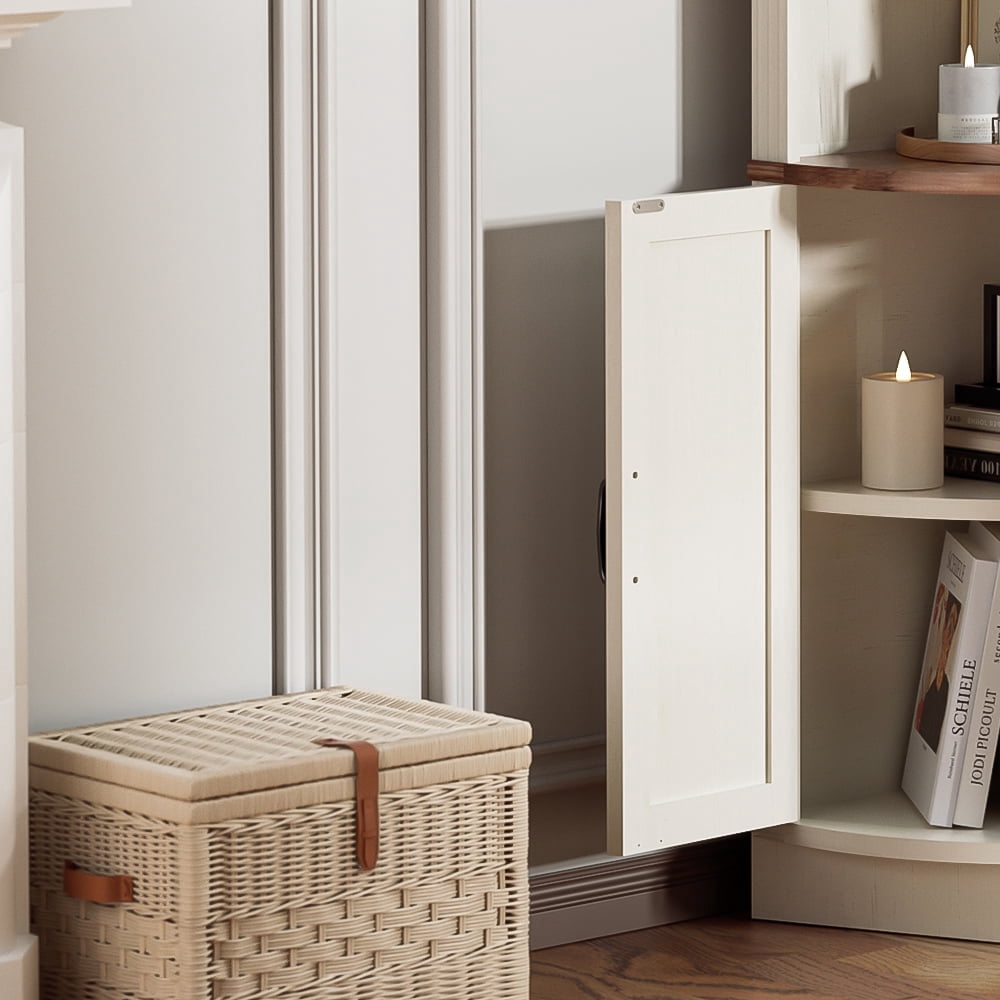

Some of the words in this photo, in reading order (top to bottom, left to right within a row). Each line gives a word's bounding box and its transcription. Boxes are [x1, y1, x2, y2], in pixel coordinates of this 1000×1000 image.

[952, 658, 977, 736] SCHIELE
[977, 688, 998, 749] PICOULT
[970, 750, 987, 786] JODI
